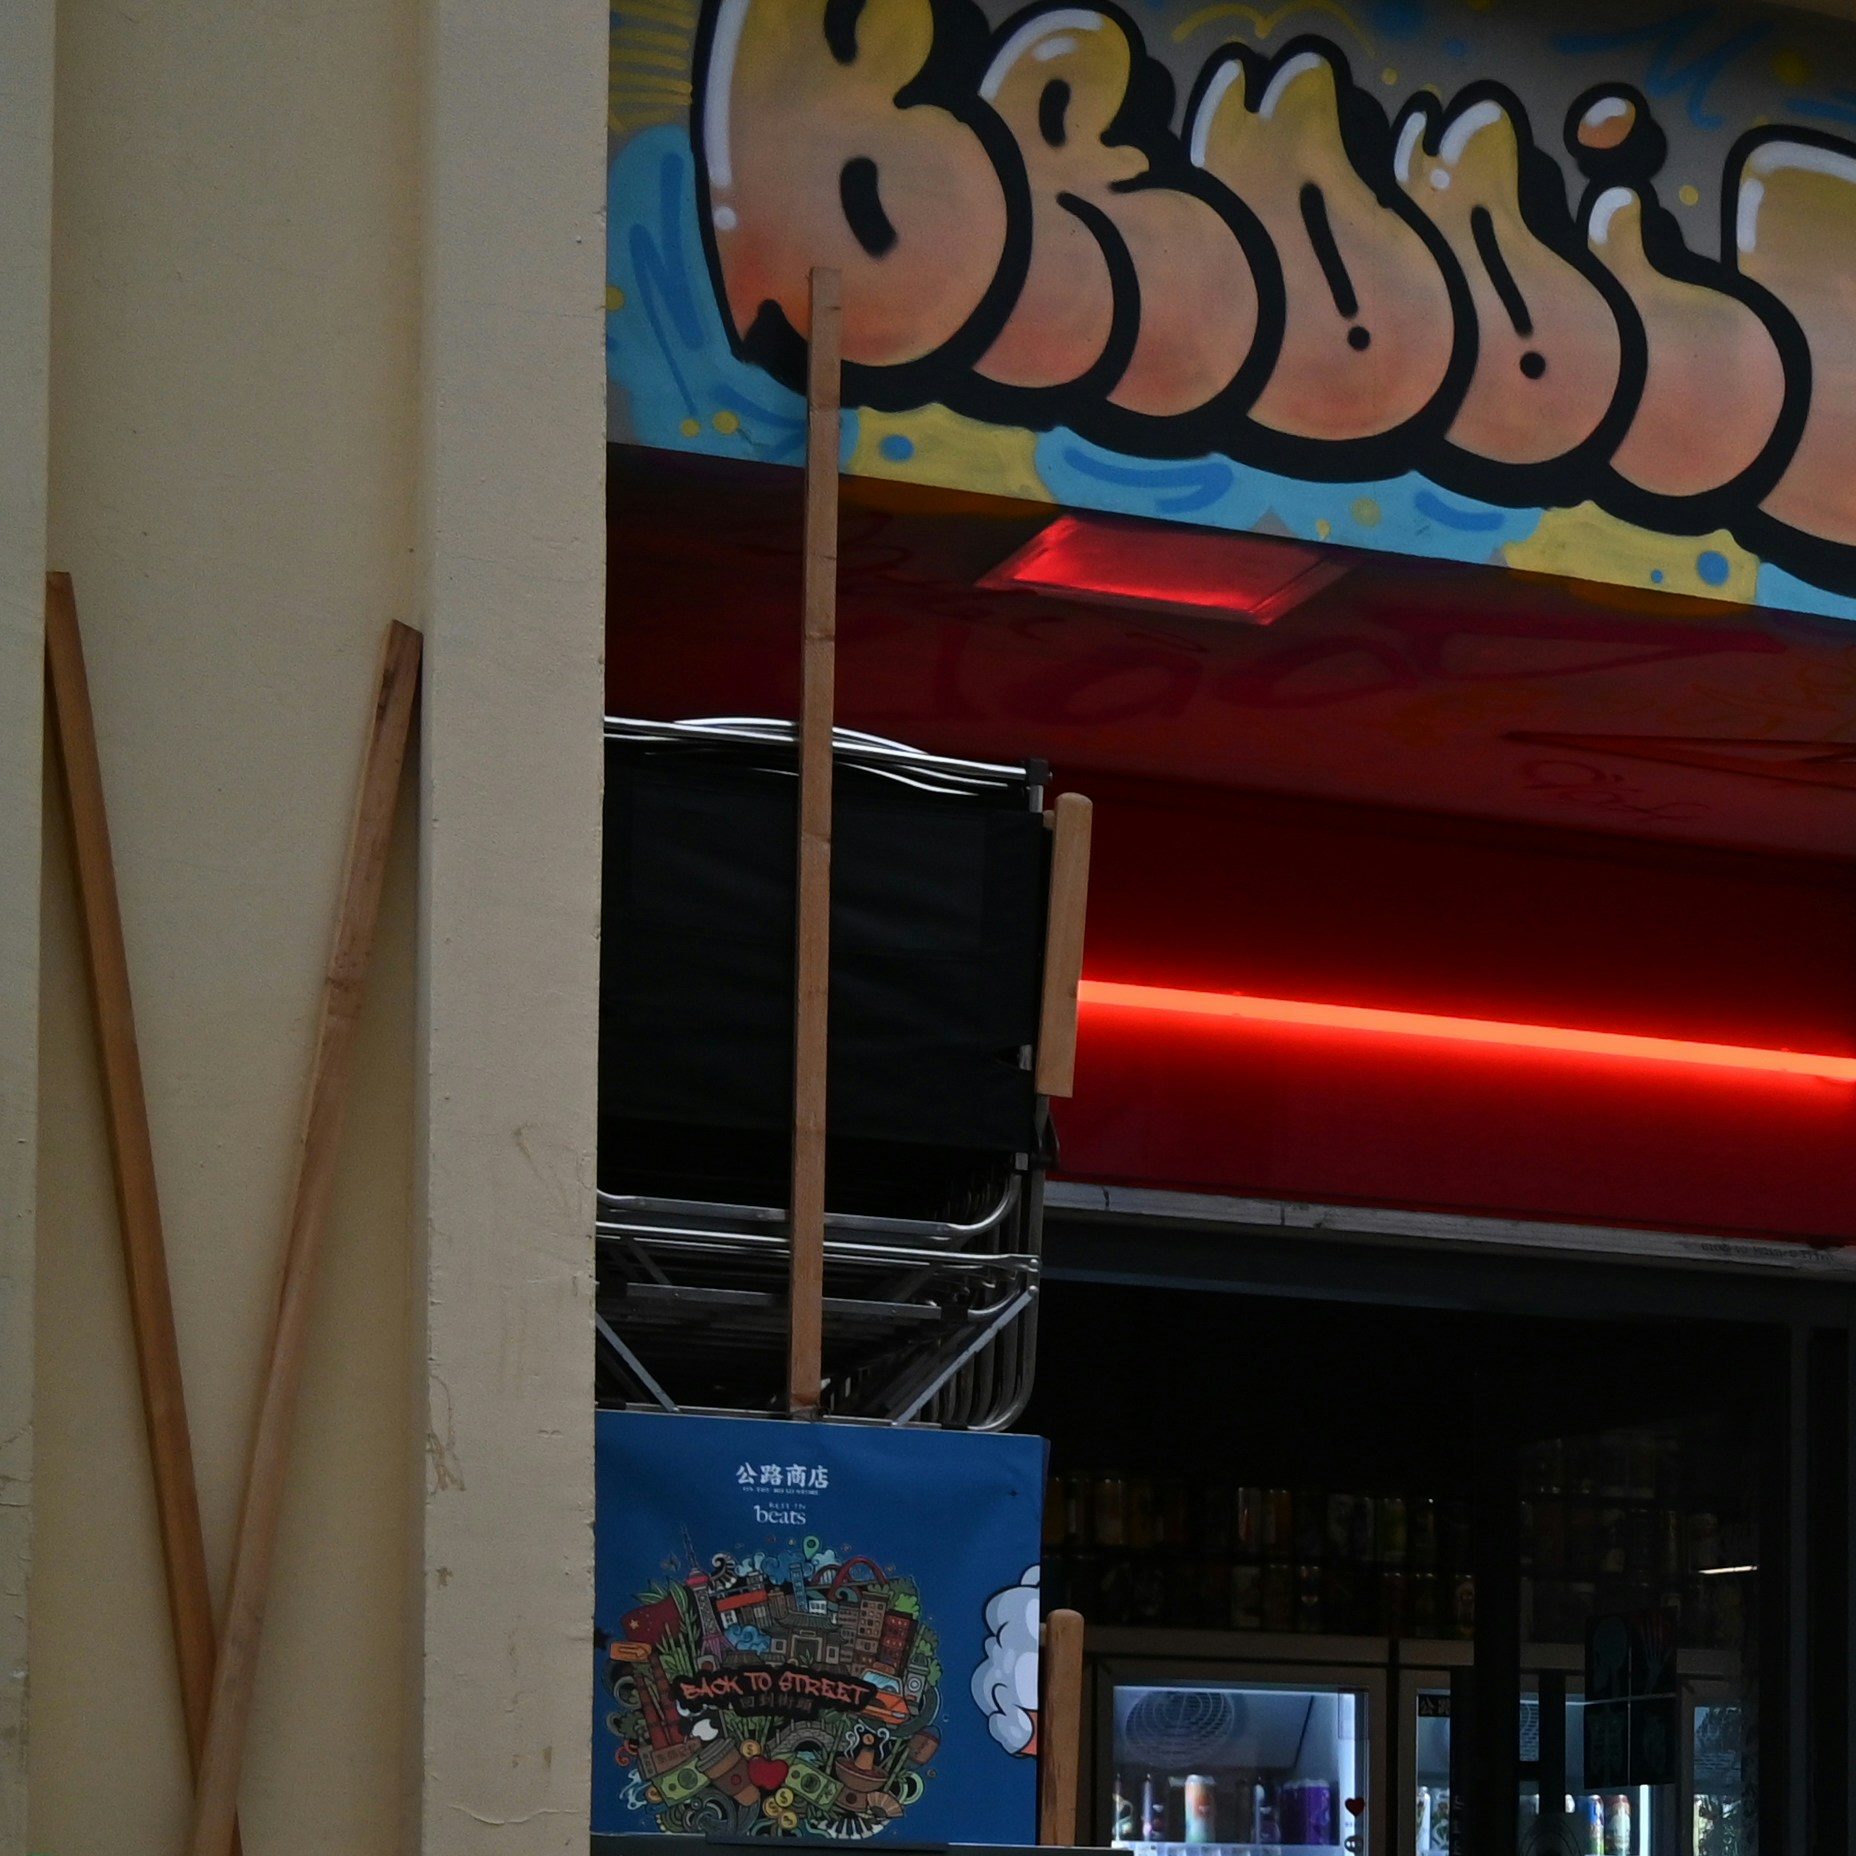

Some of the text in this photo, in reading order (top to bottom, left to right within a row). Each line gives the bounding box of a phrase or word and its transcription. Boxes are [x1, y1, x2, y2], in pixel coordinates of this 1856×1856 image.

[736, 1462, 829, 1489] 公路商店
[754, 1504, 807, 1525] beats
[681, 1671, 870, 1703] BACK TO STREET
